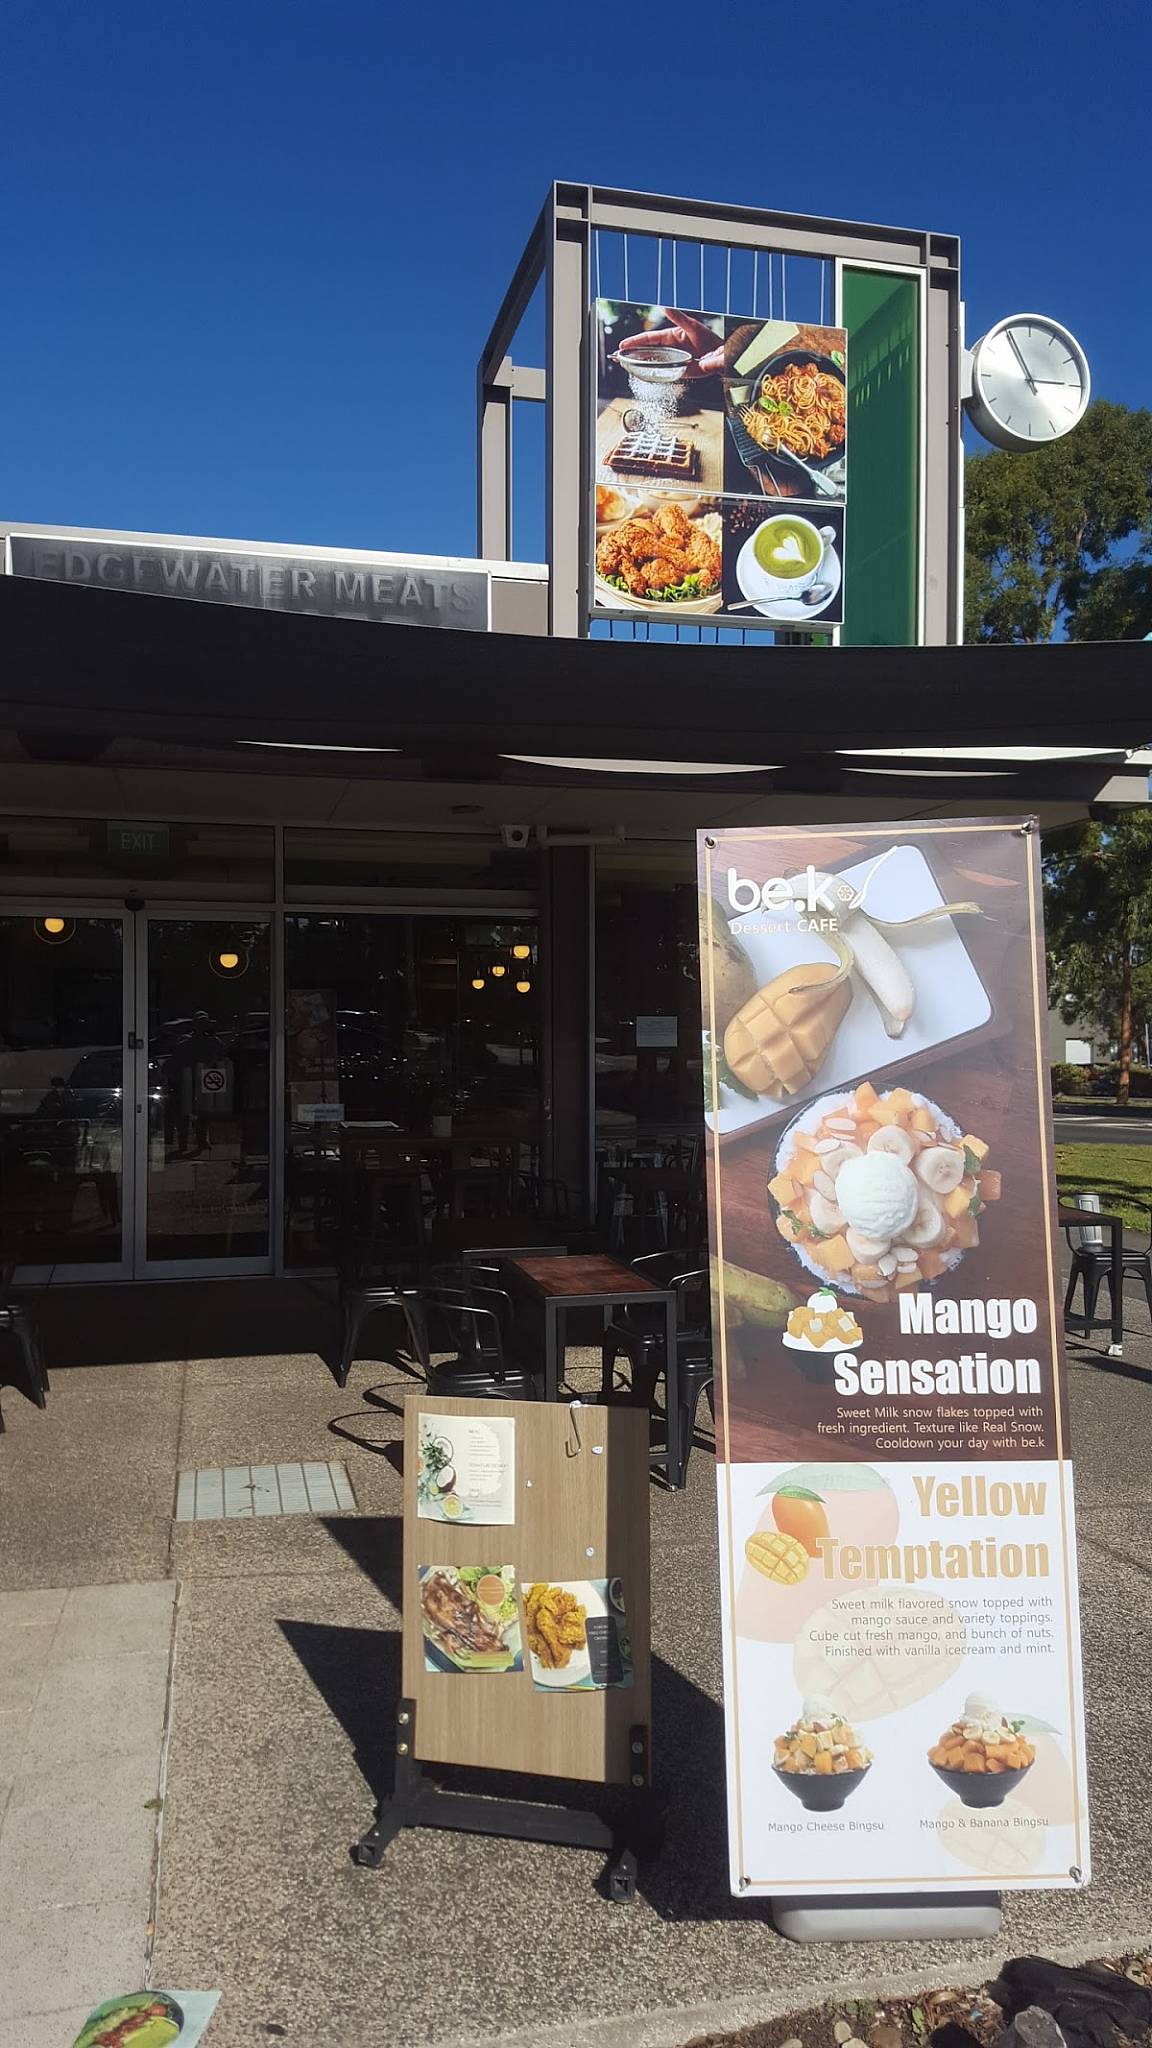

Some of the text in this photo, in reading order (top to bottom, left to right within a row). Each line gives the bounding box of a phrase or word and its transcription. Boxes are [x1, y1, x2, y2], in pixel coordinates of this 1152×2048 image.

[33, 550, 474, 612] EDGEWATER MEATS
[121, 832, 156, 849] EXIT
[728, 865, 834, 912] be.k
[731, 918, 838, 934] Dessert CAFE
[899, 1293, 1037, 1339] Mango
[834, 1353, 1041, 1395] Sensation
[837, 1406, 1042, 1420] Sweet Milk snow flakes topped with
[818, 1422, 1044, 1436] fresh ingredient. Texture like Real Snow.
[876, 1437, 1044, 1450] Cooldown your day with be.k
[913, 1475, 1047, 1517] Yellow
[816, 1537, 1050, 1583] Temptation
[832, 1597, 1052, 1610] Sweet milk flavored snow topped with
[852, 1612, 1053, 1628] mango sauce and variety toppings.
[810, 1628, 1054, 1643] Cube cut fresh mango, and bunch of nuts.
[826, 1644, 1055, 1657] Finished with vanilla icecream and mint.
[768, 1821, 884, 1833] Mango Cheese Bingsu
[920, 1817, 1048, 1830] Mango & Banana Bingsu
